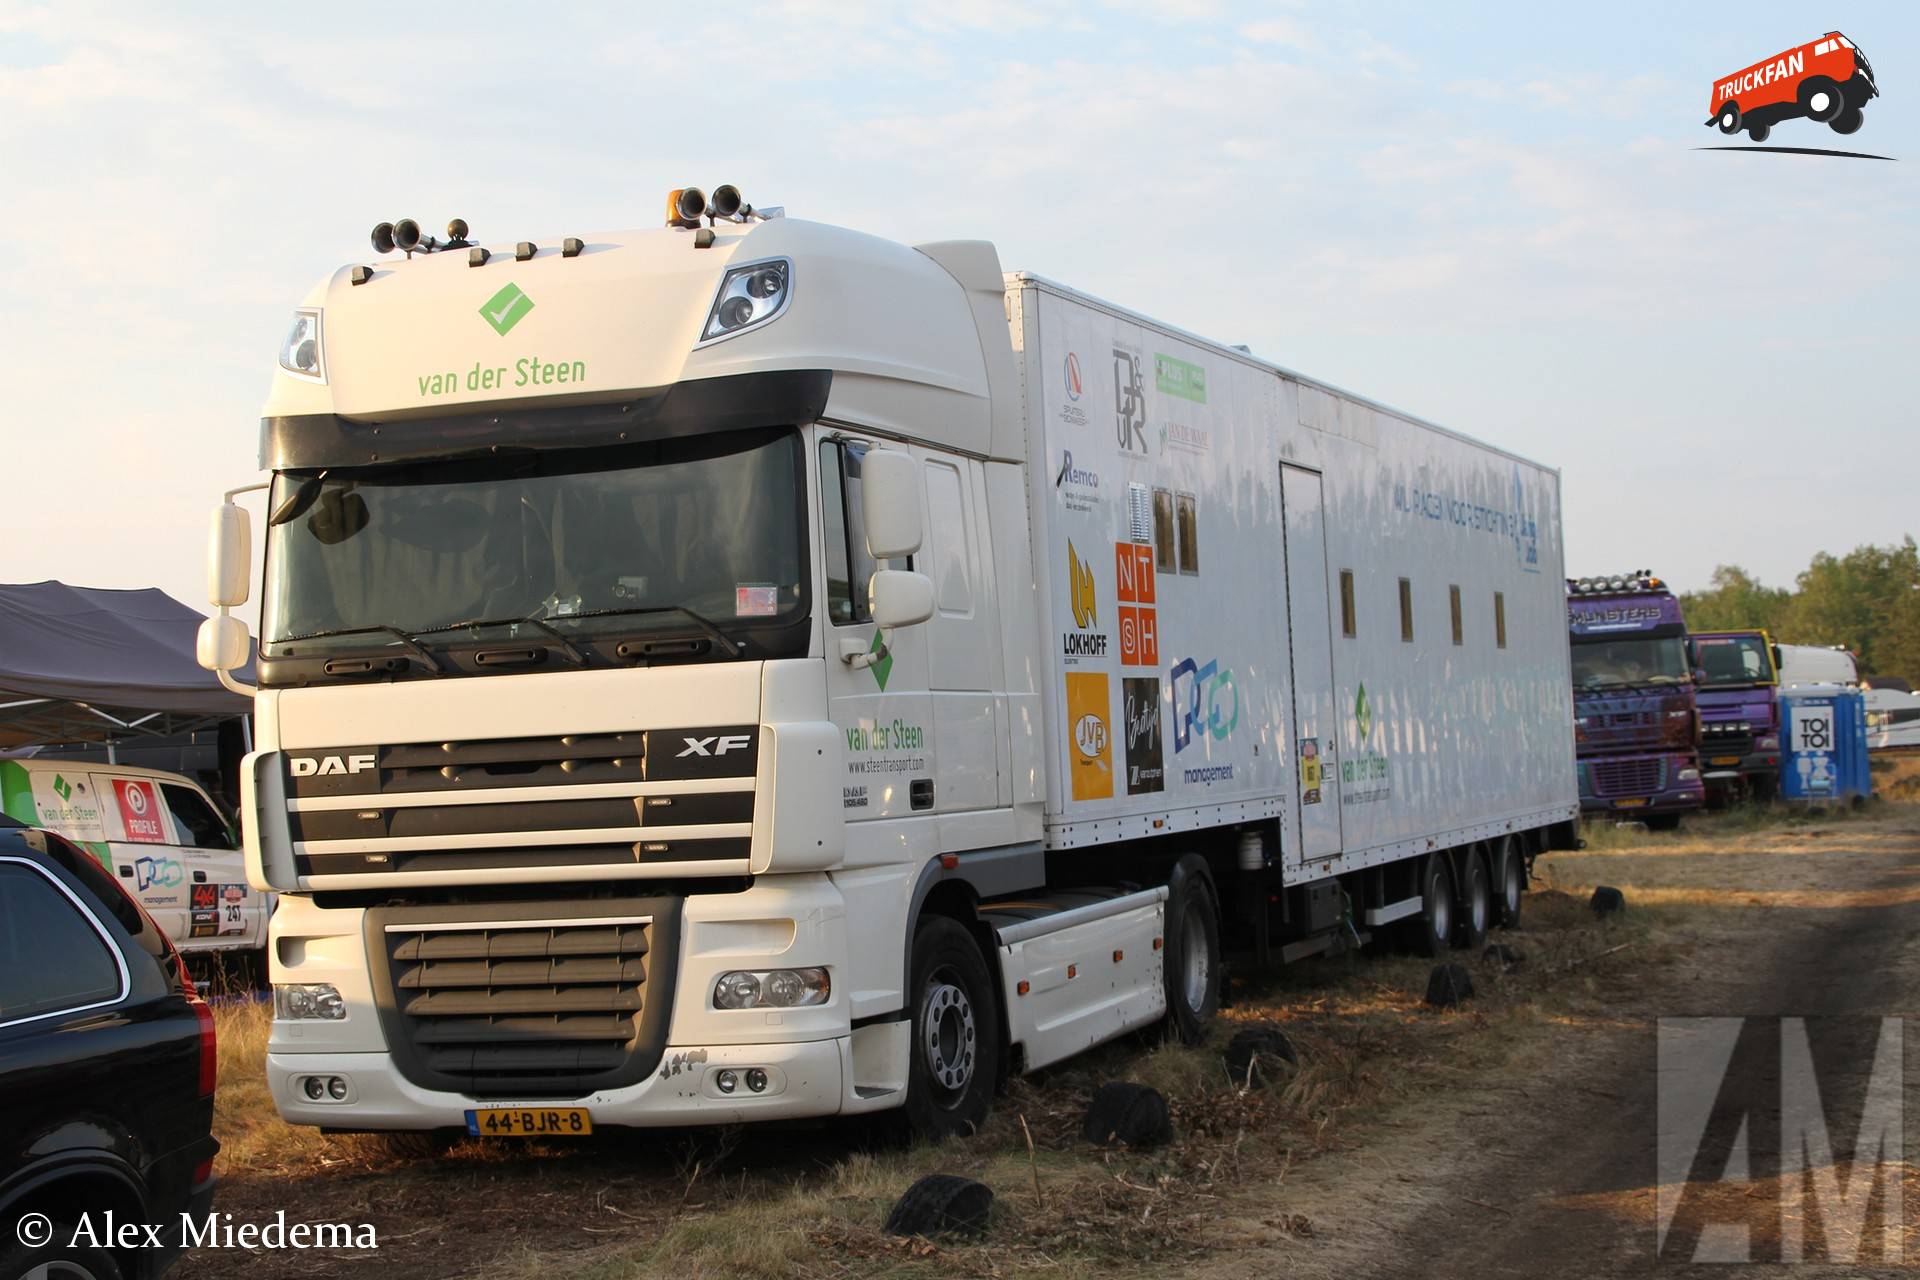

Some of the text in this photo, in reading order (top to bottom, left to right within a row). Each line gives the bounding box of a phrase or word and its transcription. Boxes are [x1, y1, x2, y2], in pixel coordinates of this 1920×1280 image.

[418, 357, 585, 396] van der Steen
[1057, 449, 1099, 488] Remco
[1064, 633, 1107, 655] LOKHOFF
[846, 718, 924, 751] van der Steen
[1801, 719, 1829, 733] TOI
[675, 735, 751, 758] XF
[1801, 734, 1829, 748] TOI
[290, 754, 376, 777] DAF
[848, 756, 925, 776] www.steentransport.com
[1184, 763, 1234, 787] management
[42, 805, 98, 821] van der Steen
[128, 819, 159, 835] PROFILE
[486, 1111, 583, 1133] 44-BJR-8
